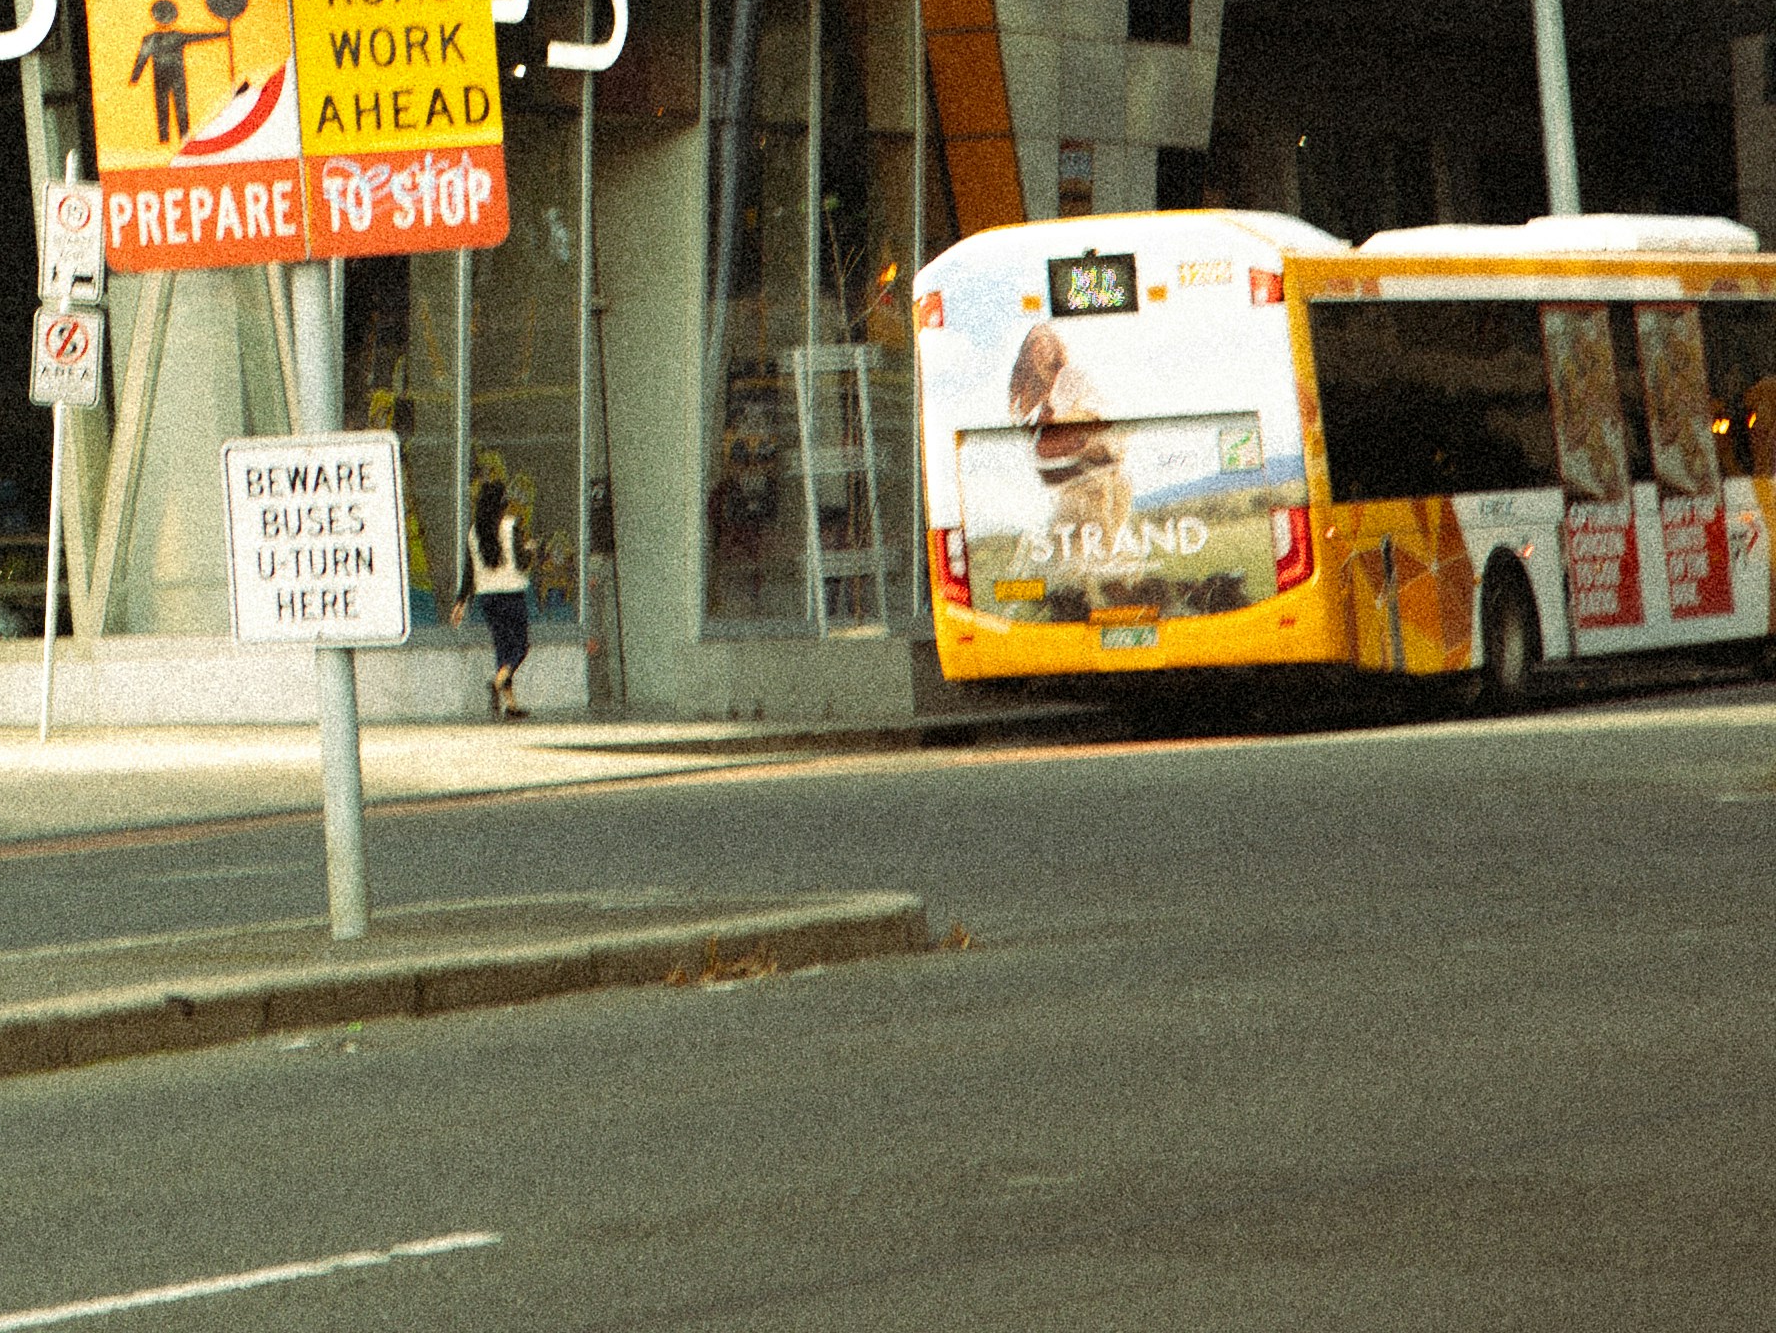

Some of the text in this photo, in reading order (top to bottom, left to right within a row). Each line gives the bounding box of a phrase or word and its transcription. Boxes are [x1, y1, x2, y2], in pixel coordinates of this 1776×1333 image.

[329, 21, 466, 69] WORK
[316, 84, 490, 134] AHEAD
[108, 179, 297, 249] PREPARE
[322, 171, 373, 233] TO
[392, 166, 493, 229] STOP
[246, 460, 377, 499] BEWARE
[261, 502, 365, 541] BUSES
[1028, 516, 1208, 563] STRAND
[257, 544, 375, 580] U-TURN
[277, 584, 362, 624] HERE
